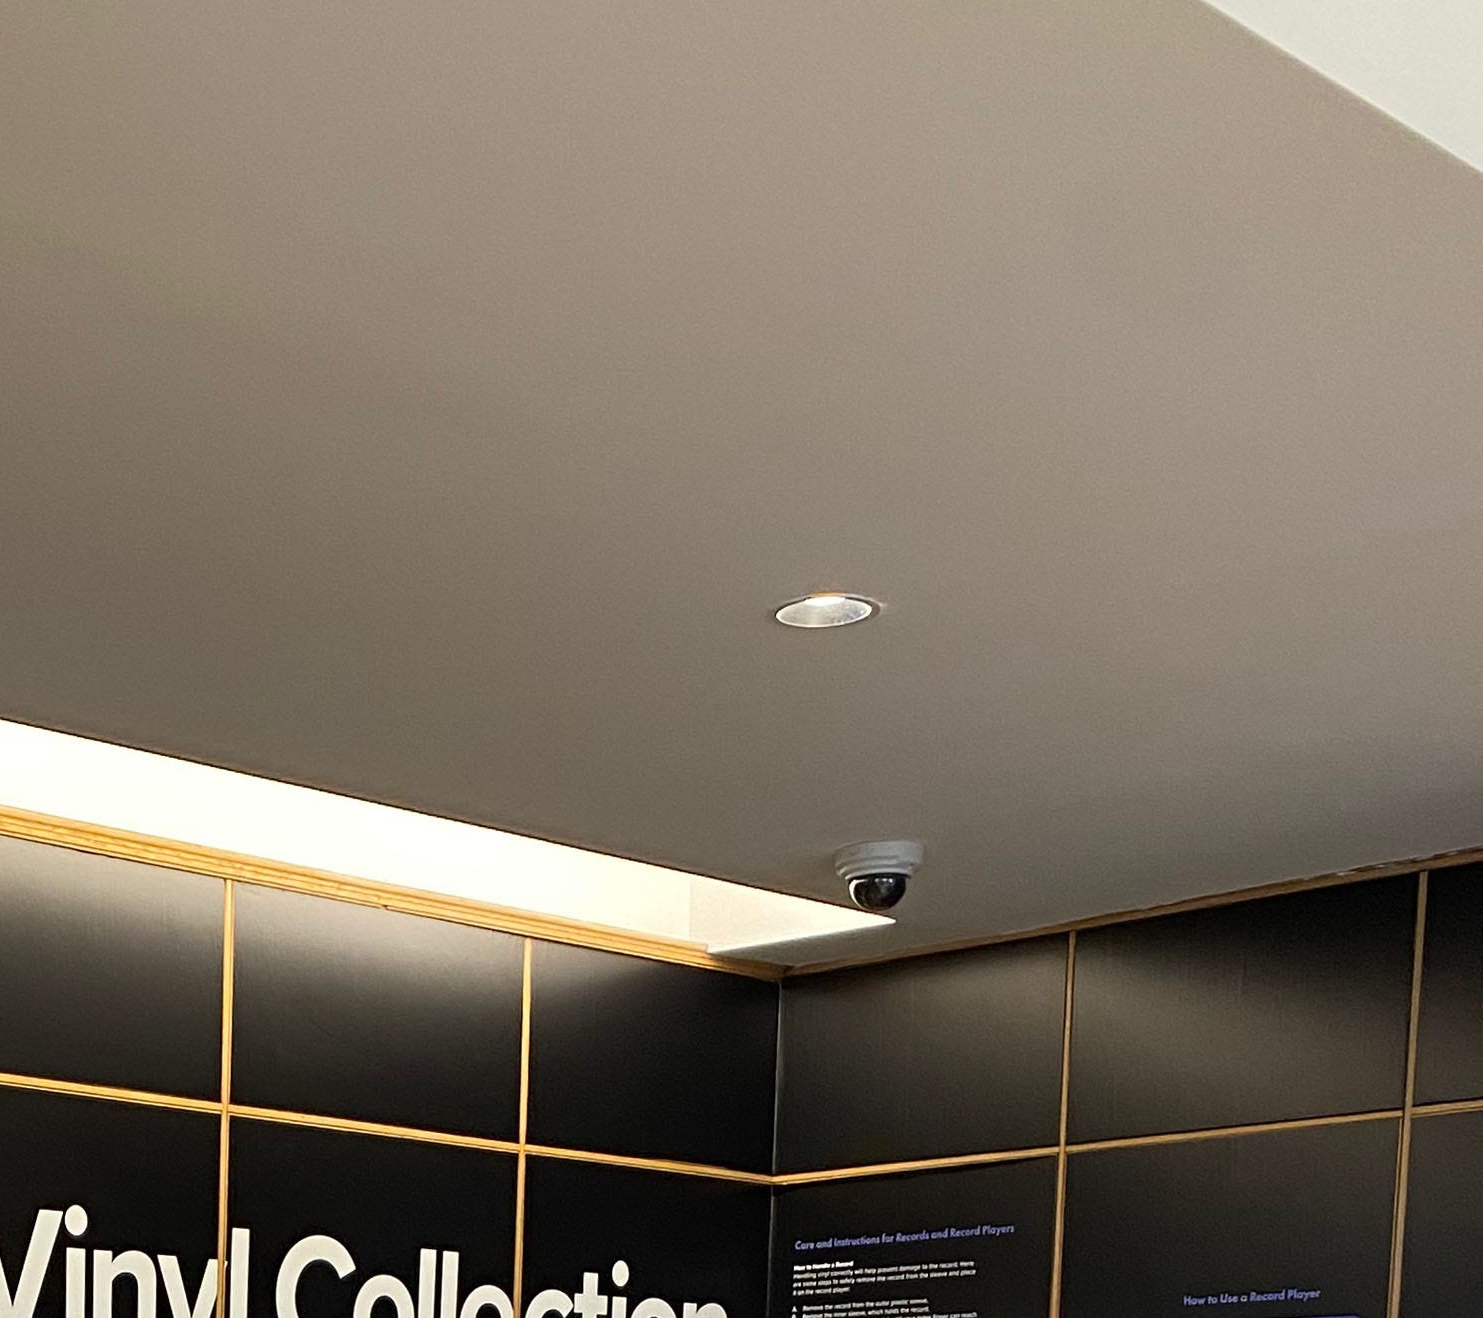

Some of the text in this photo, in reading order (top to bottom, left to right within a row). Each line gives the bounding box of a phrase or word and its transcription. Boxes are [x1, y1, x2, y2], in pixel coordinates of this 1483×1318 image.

[795, 1225, 1014, 1250] Care and Instructions for Records and Record Players
[1184, 1289, 1321, 1306] How to Use a Record Player
